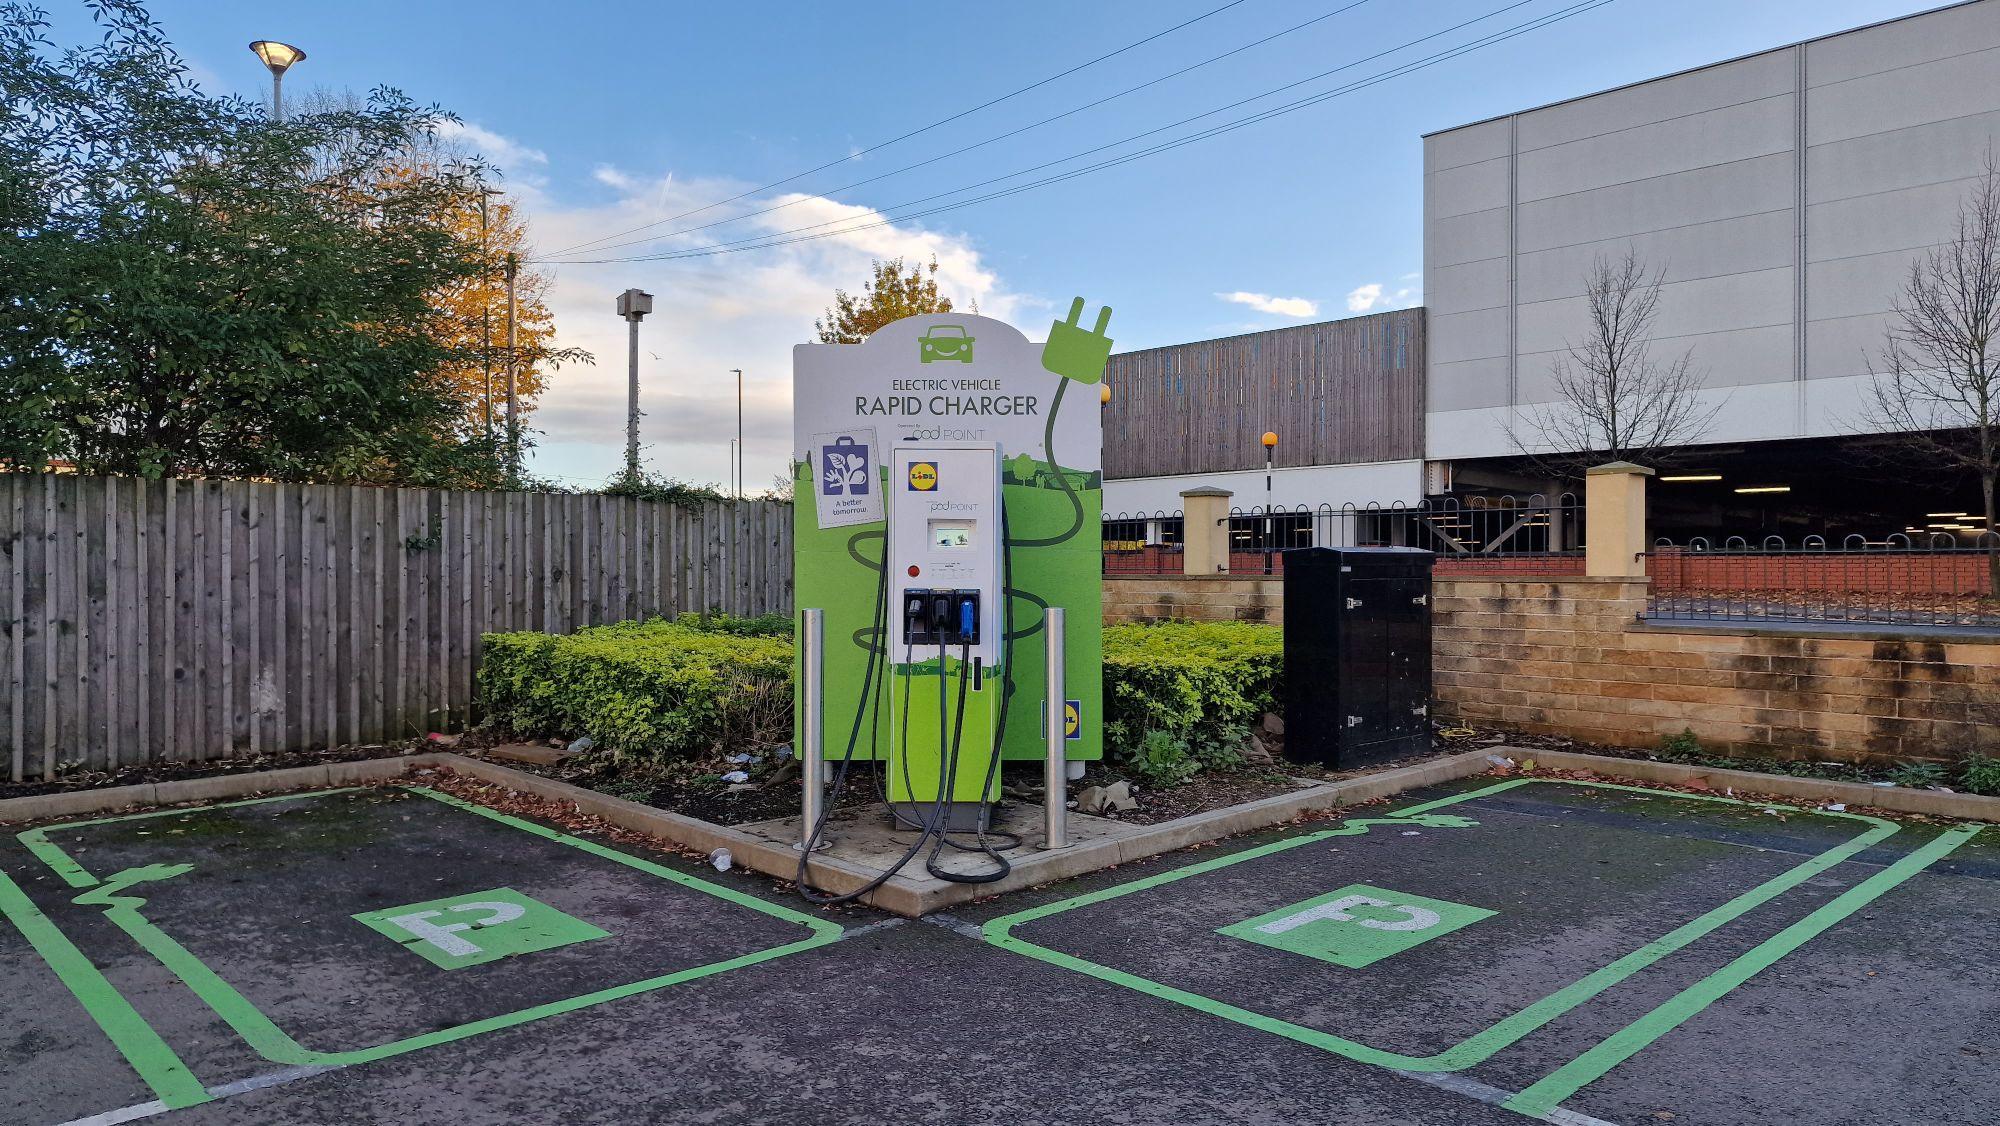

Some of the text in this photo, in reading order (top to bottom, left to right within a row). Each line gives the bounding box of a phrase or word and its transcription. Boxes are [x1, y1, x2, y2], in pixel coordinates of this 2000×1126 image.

[892, 379, 1001, 391] ELECTRIC VEHICLE
[855, 396, 1038, 416] RAPID CHARGER
[943, 429, 986, 441] POINT
[842, 499, 863, 507] better
[930, 500, 979, 513] pod POINT
